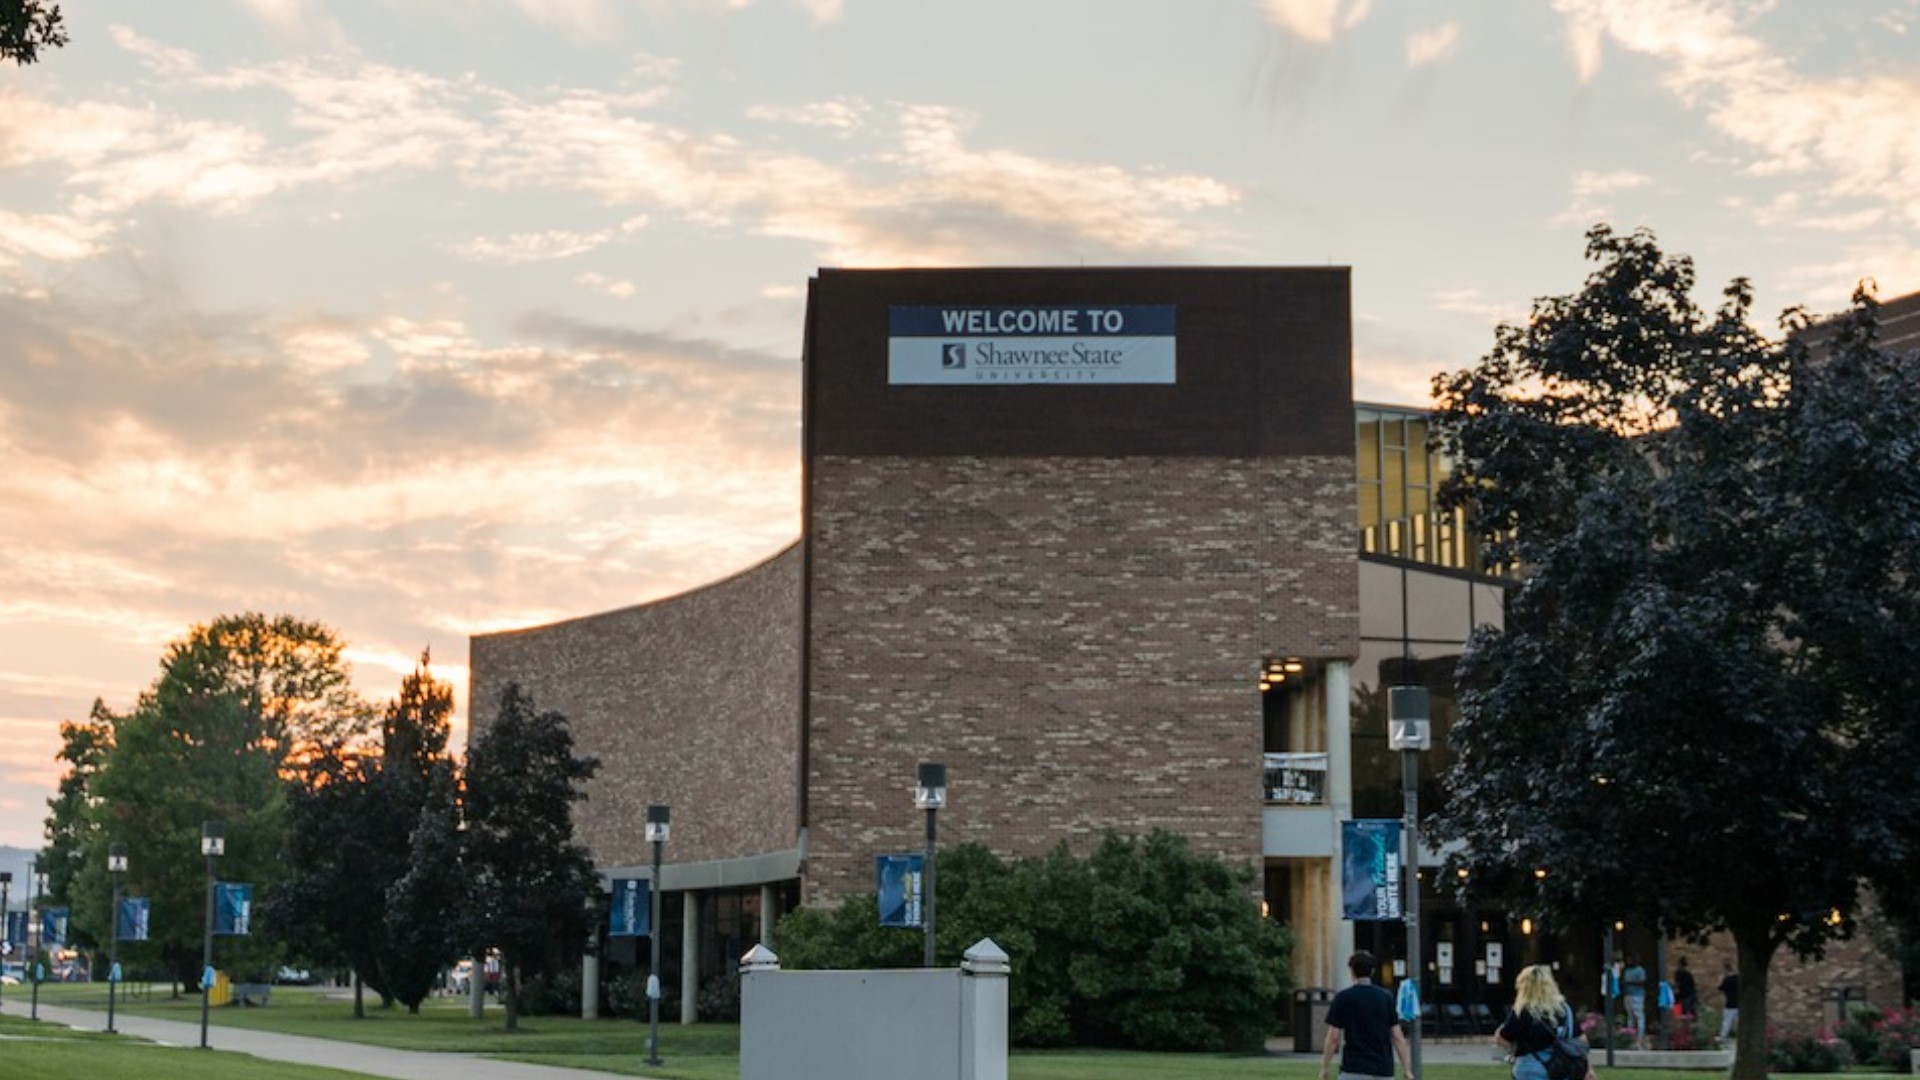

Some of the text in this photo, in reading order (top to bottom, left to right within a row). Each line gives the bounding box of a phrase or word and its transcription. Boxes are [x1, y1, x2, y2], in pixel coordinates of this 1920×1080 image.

[942, 310, 1124, 333] WELCOME TO
[975, 342, 1123, 365] Shawnee State
[976, 370, 1097, 380] UNIVERSITY
